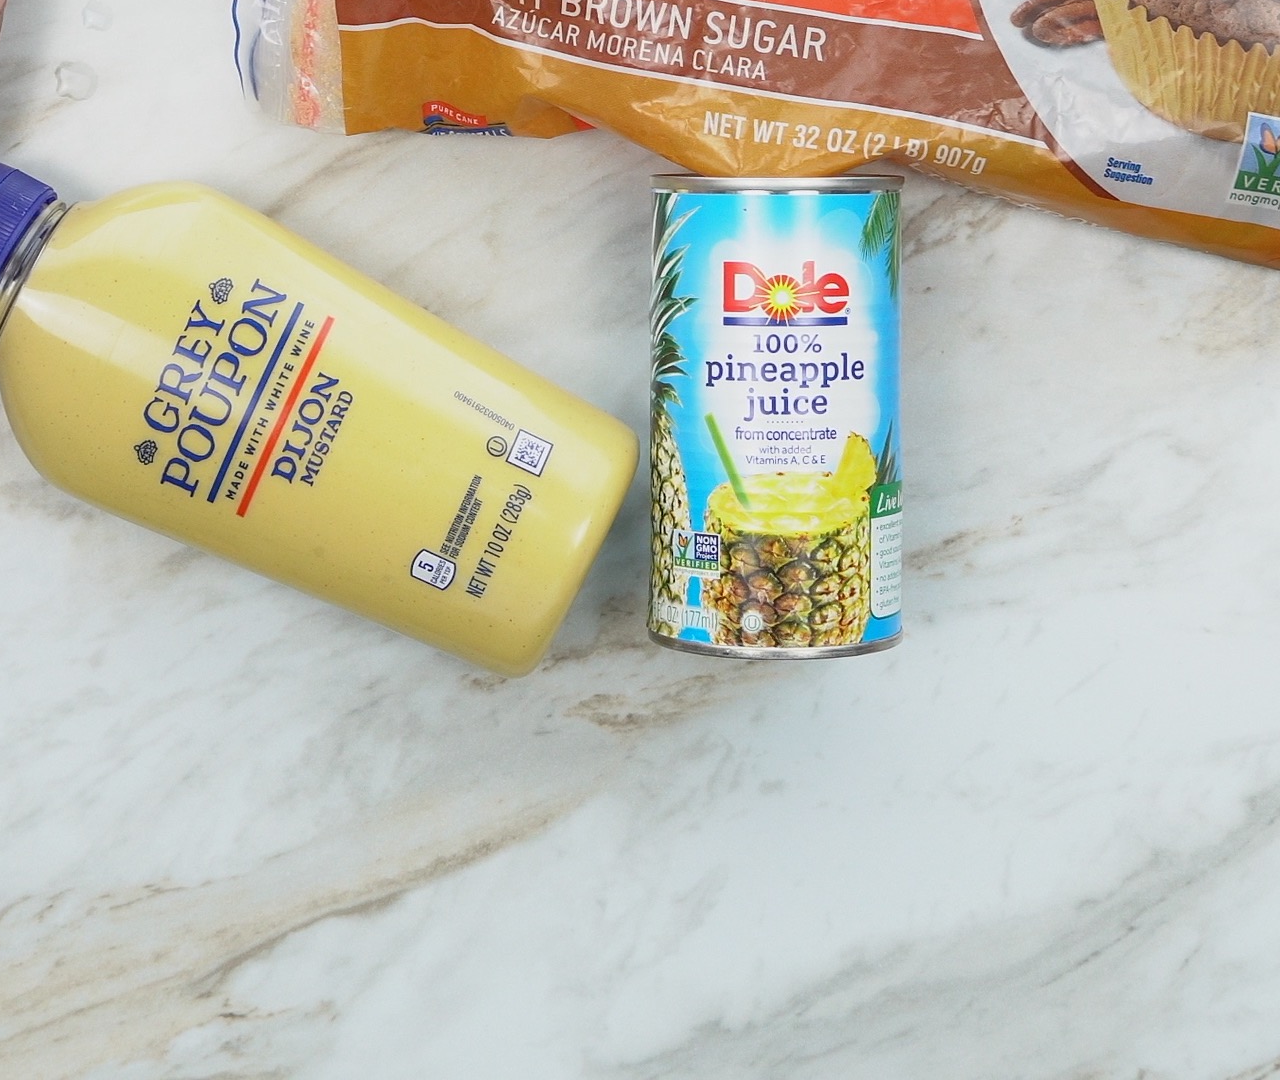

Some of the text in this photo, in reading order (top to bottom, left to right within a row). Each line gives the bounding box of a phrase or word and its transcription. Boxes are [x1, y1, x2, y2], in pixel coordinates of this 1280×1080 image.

[491, 3, 766, 81] AZÚCAR MORENA CLARA
[703, 11, 827, 61] SUGAR
[430, 104, 479, 125] PURE CANE
[703, 110, 747, 140] NET
[752, 118, 788, 145] WT
[792, 124, 819, 149] 32
[826, 128, 858, 155] OZ
[863, 132, 886, 159] (2
[932, 144, 987, 175] 907g
[1104, 168, 1153, 186] Suggestion
[1107, 157, 1142, 174] Serving
[723, 261, 850, 321] Dole
[753, 334, 822, 354] 100%
[143, 299, 226, 433] GREY
[706, 352, 865, 389] pineapple
[160, 278, 287, 498] POUPON
[744, 387, 828, 421] juice
[225, 319, 315, 500] MADE WITH WHITE WINE
[271, 371, 339, 484] DIJON
[300, 390, 353, 487] MUSTARD
[735, 426, 837, 441] from concentrate
[745, 455, 789, 465] Vitamins
[802, 455, 810, 465] C
[811, 455, 819, 464] &
[820, 455, 826, 464] E
[759, 445, 812, 454] with added
[439, 474, 482, 555] SEE NUTRITION INFORMATION
[449, 498, 483, 559] FOR SODIUM CONTENT
[465, 483, 532, 599] NET WT 10 OZ (283g)
[696, 535, 717, 545] NON
[696, 544, 718, 554] GMO
[696, 552, 717, 560] Project
[418, 560, 434, 572] 5
[430, 559, 447, 584] CALORIES
[676, 558, 718, 570] VERIFIED
